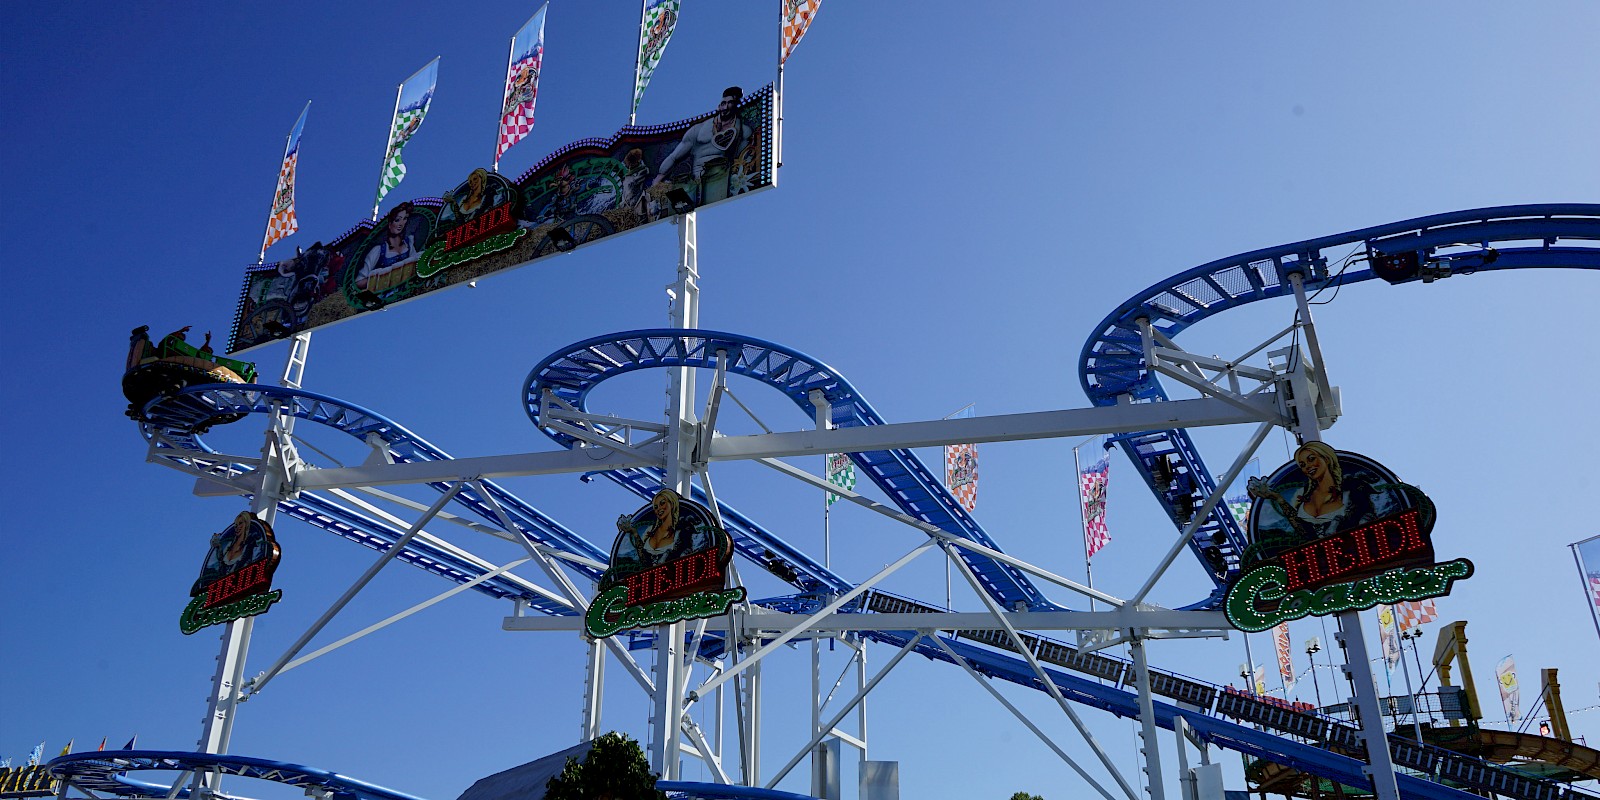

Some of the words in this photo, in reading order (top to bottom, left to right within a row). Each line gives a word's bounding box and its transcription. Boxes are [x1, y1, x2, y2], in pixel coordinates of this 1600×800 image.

[444, 202, 511, 251] HEIDI
[416, 228, 527, 278] Coaster
[1281, 511, 1426, 592] HEIDI
[203, 558, 268, 608] HEIDI
[625, 548, 720, 607] HEIDI
[1226, 559, 1471, 631] Coaster
[180, 589, 281, 634] Coaster
[586, 586, 746, 638] Coaster
